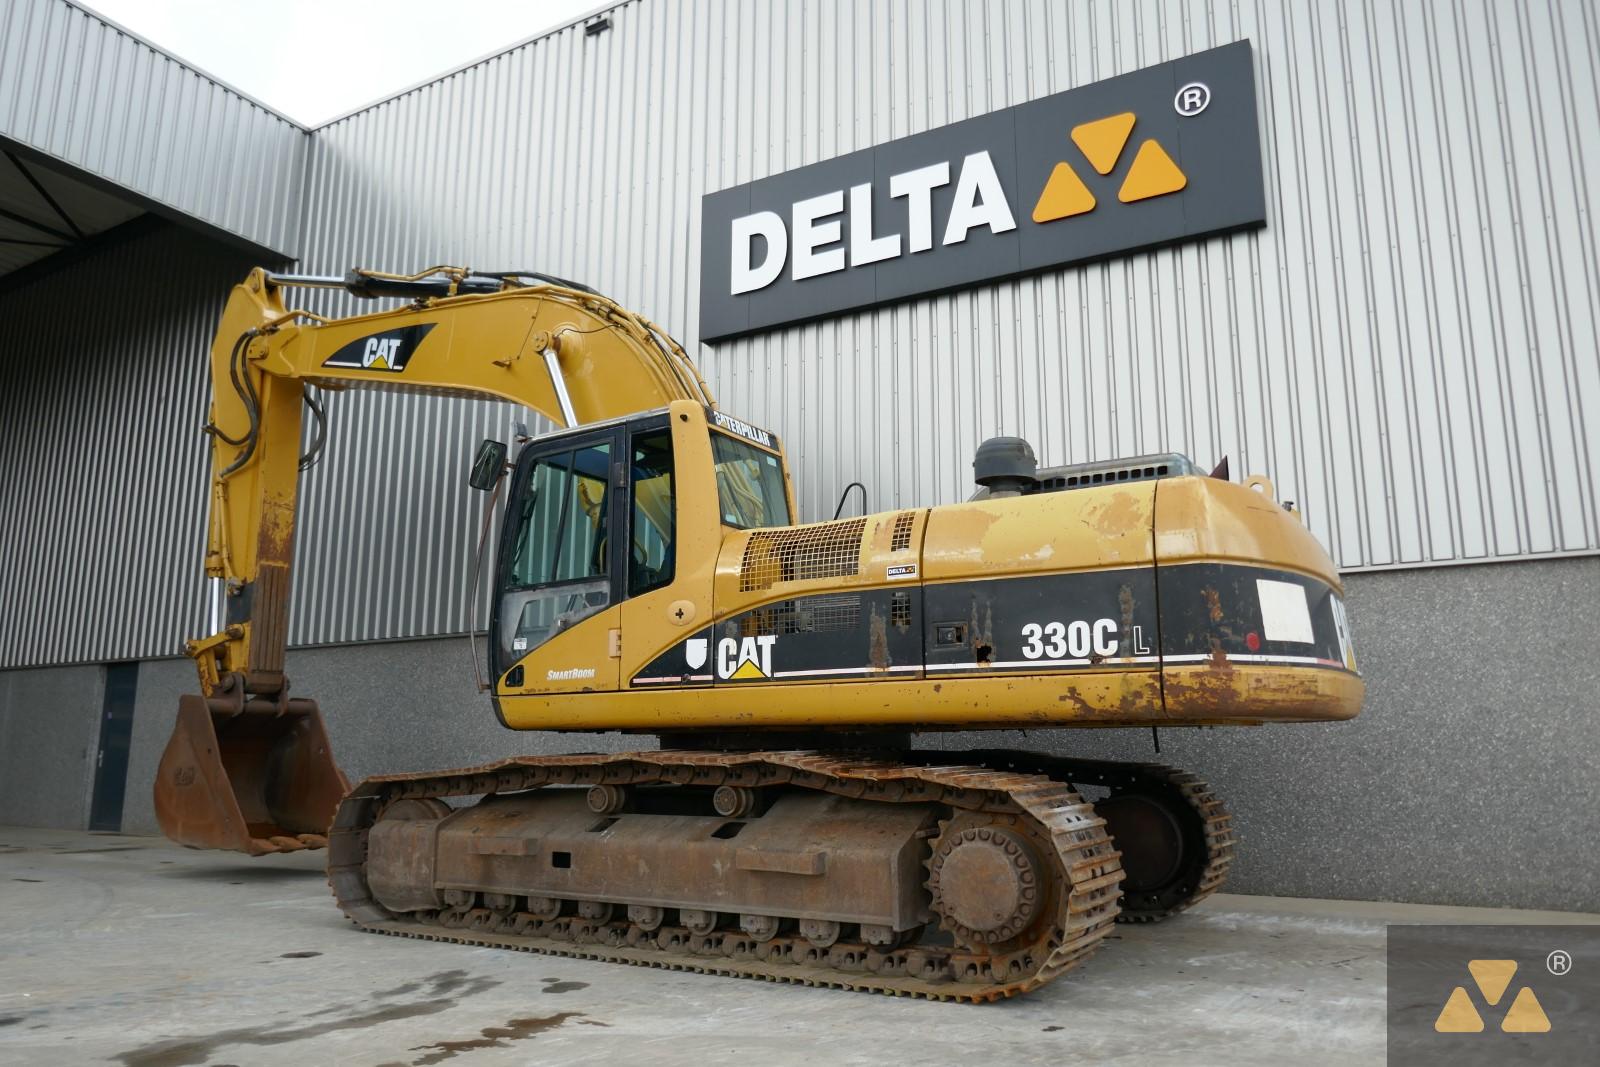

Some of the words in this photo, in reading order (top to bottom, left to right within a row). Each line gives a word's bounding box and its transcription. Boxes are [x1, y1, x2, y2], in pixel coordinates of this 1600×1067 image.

[730, 150, 1017, 296] DELTA
[362, 337, 403, 370] CAT
[713, 410, 771, 447] CATERPILLAR
[717, 634, 776, 680] CAT
[1021, 618, 1119, 659] 330C
[1133, 625, 1150, 655] L
